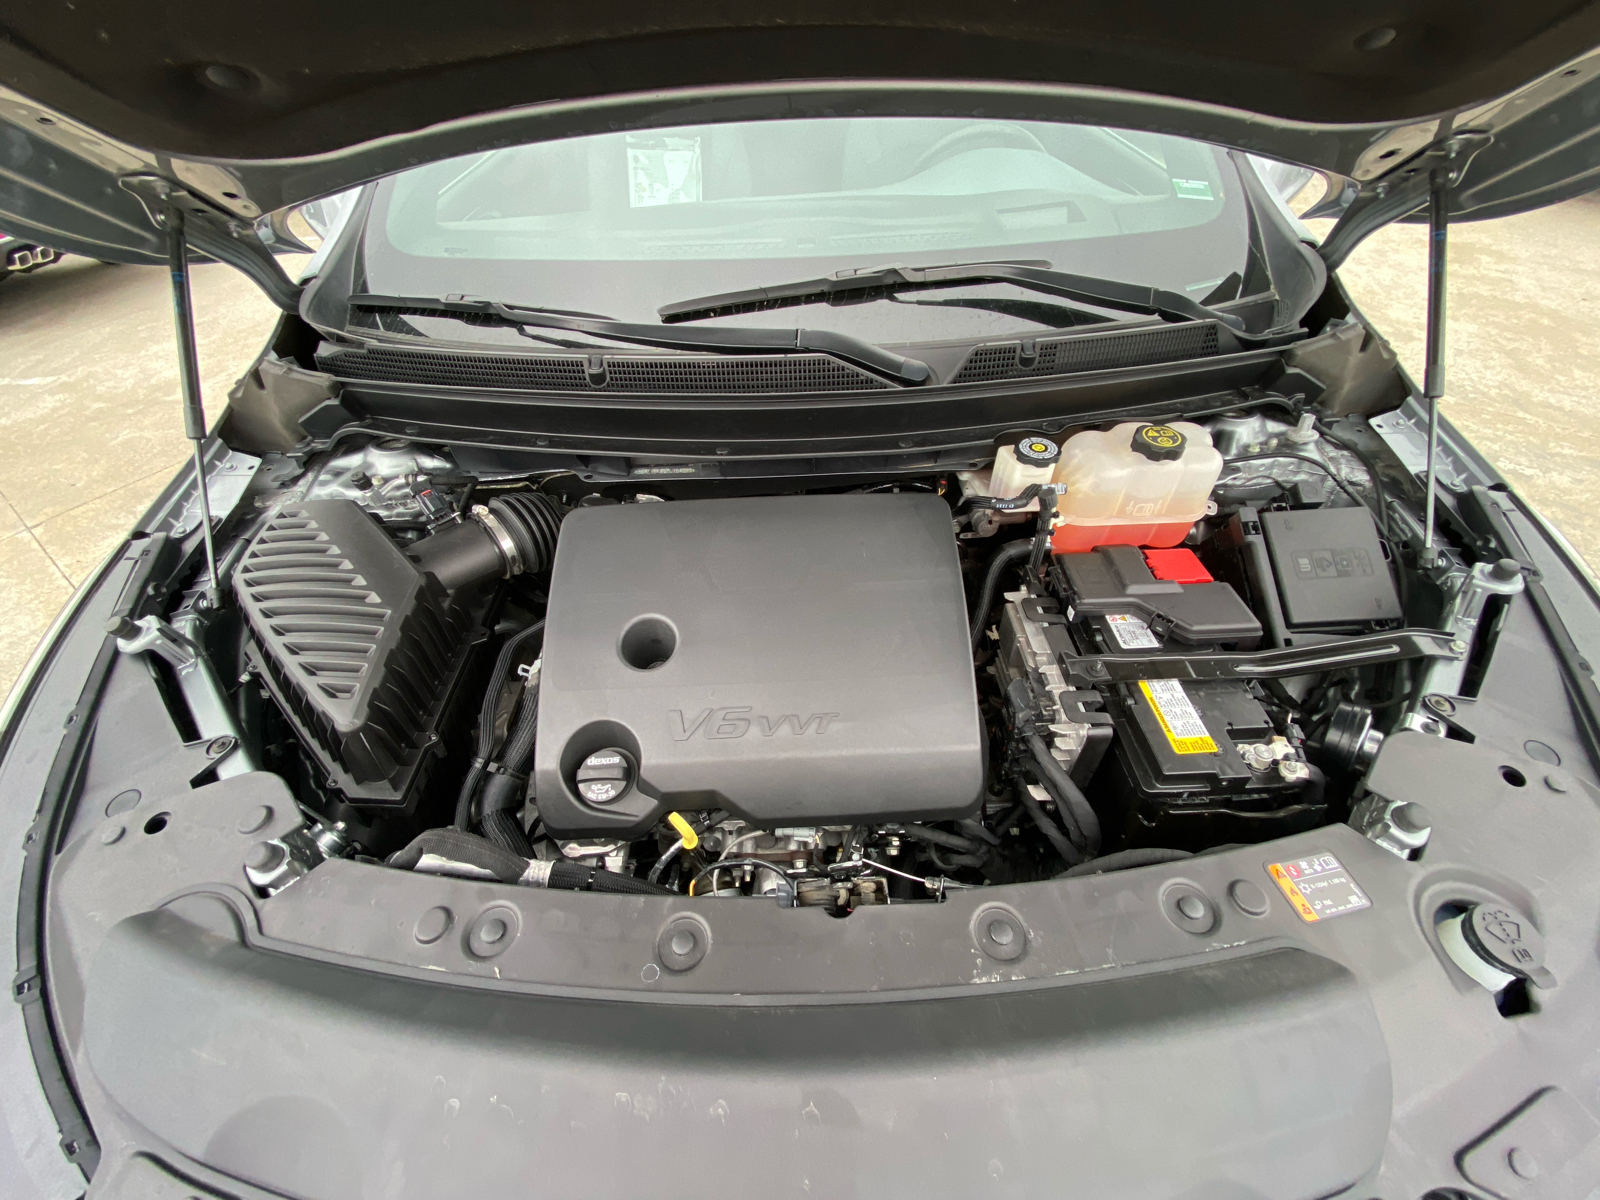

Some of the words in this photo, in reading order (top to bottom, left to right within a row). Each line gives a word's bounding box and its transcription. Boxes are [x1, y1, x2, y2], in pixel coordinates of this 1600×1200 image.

[667, 706, 752, 741] V6
[758, 712, 840, 737] VVT
[587, 757, 621, 765] dexos
